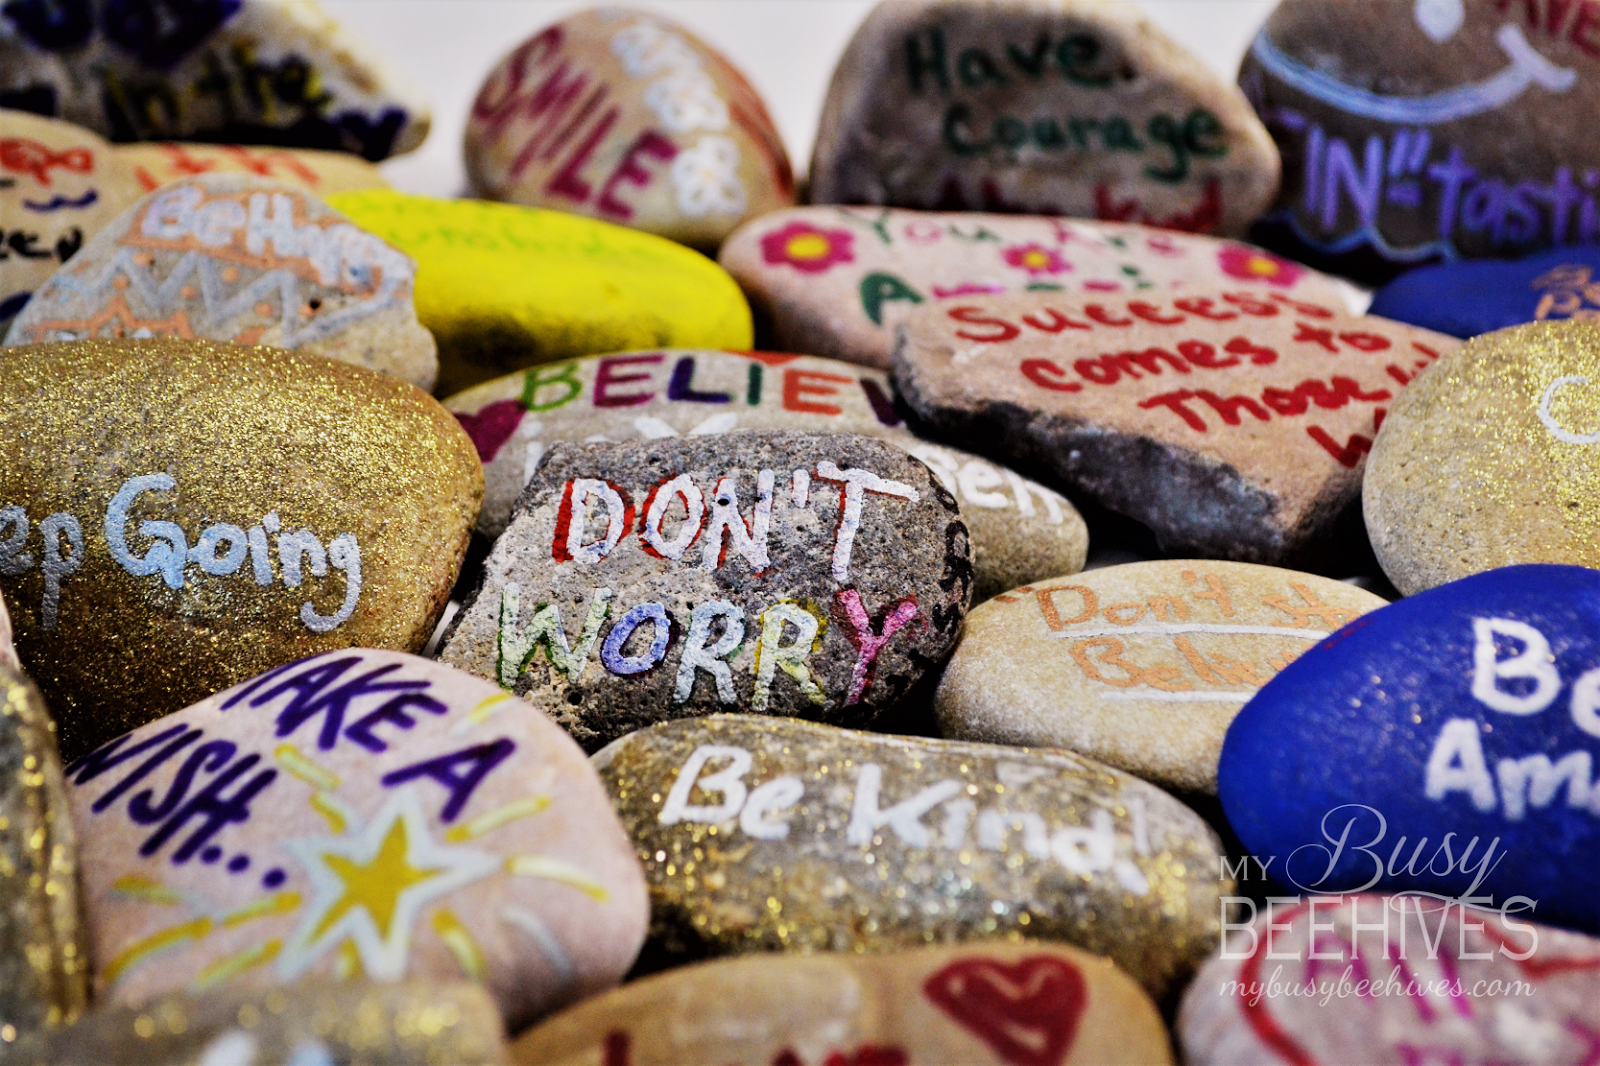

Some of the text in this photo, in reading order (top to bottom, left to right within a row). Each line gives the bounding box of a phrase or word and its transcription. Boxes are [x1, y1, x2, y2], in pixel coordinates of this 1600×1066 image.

[905, 25, 1114, 92] Have
[472, 25, 680, 220] SMILE
[106, 471, 363, 633] Going
[552, 460, 920, 584] DON'T
[496, 582, 923, 713] WORRY
[380, 737, 518, 824] A
[660, 744, 805, 841] Be
